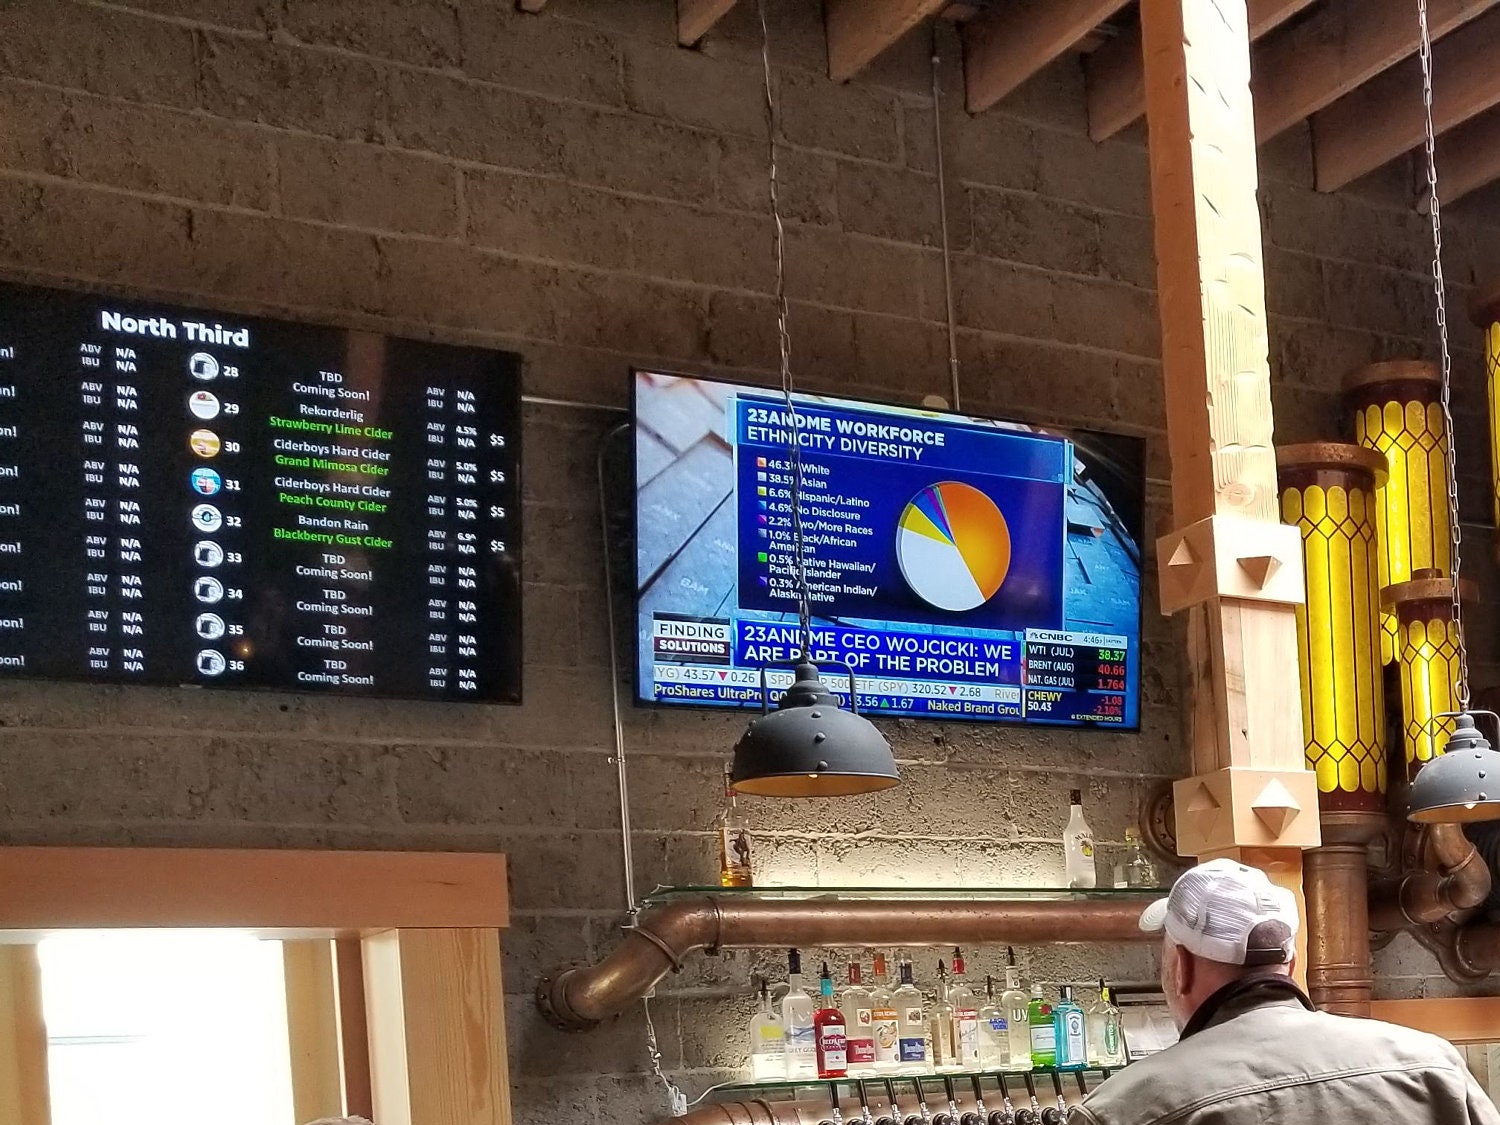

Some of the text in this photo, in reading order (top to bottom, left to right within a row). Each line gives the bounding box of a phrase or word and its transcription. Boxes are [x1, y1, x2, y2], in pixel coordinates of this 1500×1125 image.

[101, 311, 249, 347] North Third
[80, 343, 136, 359] ABV N/A
[82, 357, 137, 372] IBU N/A
[223, 366, 239, 378] 28
[319, 371, 342, 383] TBD
[293, 382, 370, 400] Coming Soon!
[224, 403, 239, 414] 29
[300, 404, 364, 422] Rekorderlig
[270, 416, 393, 439] Strawberry Lime Cider
[427, 422, 445, 431] ABV
[747, 408, 945, 446] 23ANDME WORKFORCE
[428, 434, 476, 447] IBU N/A
[490, 433, 505, 446] $5
[748, 426, 923, 460] ETHNICITY DIVERSITY
[225, 442, 240, 452] 30
[274, 439, 390, 461] Ciderboys Hard Cider
[275, 455, 389, 475] Grand Mimosa Cider
[456, 461, 477, 472] 5.0%
[768, 460, 830, 475] 46.3 White
[490, 469, 505, 482] $5
[226, 480, 241, 490] 31
[275, 477, 391, 497] Ciderboys Hard Cider
[801, 478, 827, 488] Asian
[769, 488, 792, 498] 6.6%
[280, 493, 387, 512] Peach County Cider
[490, 505, 505, 518] $5
[769, 503, 860, 520] 4.6% Disclosure
[227, 516, 241, 527] 32
[299, 515, 369, 530] Bandon Rain
[769, 516, 873, 535] 2.2% wo/More Races
[274, 528, 393, 548] Blackberry Gust Cider
[769, 530, 790, 541] 1.0%
[491, 539, 505, 552] $5
[227, 552, 242, 563] 33
[322, 553, 345, 565] TBD
[769, 555, 793, 564] 0.5%
[799, 558, 826, 567] ative
[296, 566, 372, 580] Coming Soon!
[804, 568, 841, 579] Islander
[769, 578, 793, 588] 0.3%
[228, 589, 242, 598] 34
[323, 589, 346, 600] TBD
[297, 601, 372, 615] Coming Soon!
[229, 625, 244, 635] 35
[323, 625, 346, 635] TBD
[660, 624, 725, 638] FINDING
[1040, 633, 1072, 641] CNBC
[297, 637, 373, 650] Coming Soon!
[660, 640, 725, 653] SOLUTIONS
[842, 633, 880, 649] CEO
[886, 636, 978, 657] WOJCICKI:
[984, 644, 1011, 659] WE
[1029, 645, 1074, 657] WTI (JUL)
[1098, 649, 1125, 661] 38.37
[230, 660, 244, 670] 36
[324, 660, 347, 669] TBD
[744, 646, 788, 661] ARE
[845, 653, 870, 668] OF
[876, 654, 910, 671] THE
[917, 658, 999, 677] PROBLEM
[1029, 660, 1074, 672] BRENT (AUG)
[1098, 664, 1125, 675] 40.66
[298, 672, 374, 684] Coming Soon!
[684, 669, 755, 683] 43.57 0.26
[1028, 675, 1074, 687] NAT. GAS (JUL)
[879, 681, 909, 694] (SPY)
[912, 685, 946, 695] 320.52
[959, 687, 981, 696] 2.68
[1098, 679, 1124, 689] 1.764
[654, 684, 715, 697] ProShares
[1028, 691, 1062, 702] CHEWY
[892, 698, 914, 708] 1.67
[928, 701, 994, 713] Naked Brand
[1028, 701, 1051, 711] 50.43
[1013, 1009, 1028, 1022] UV
